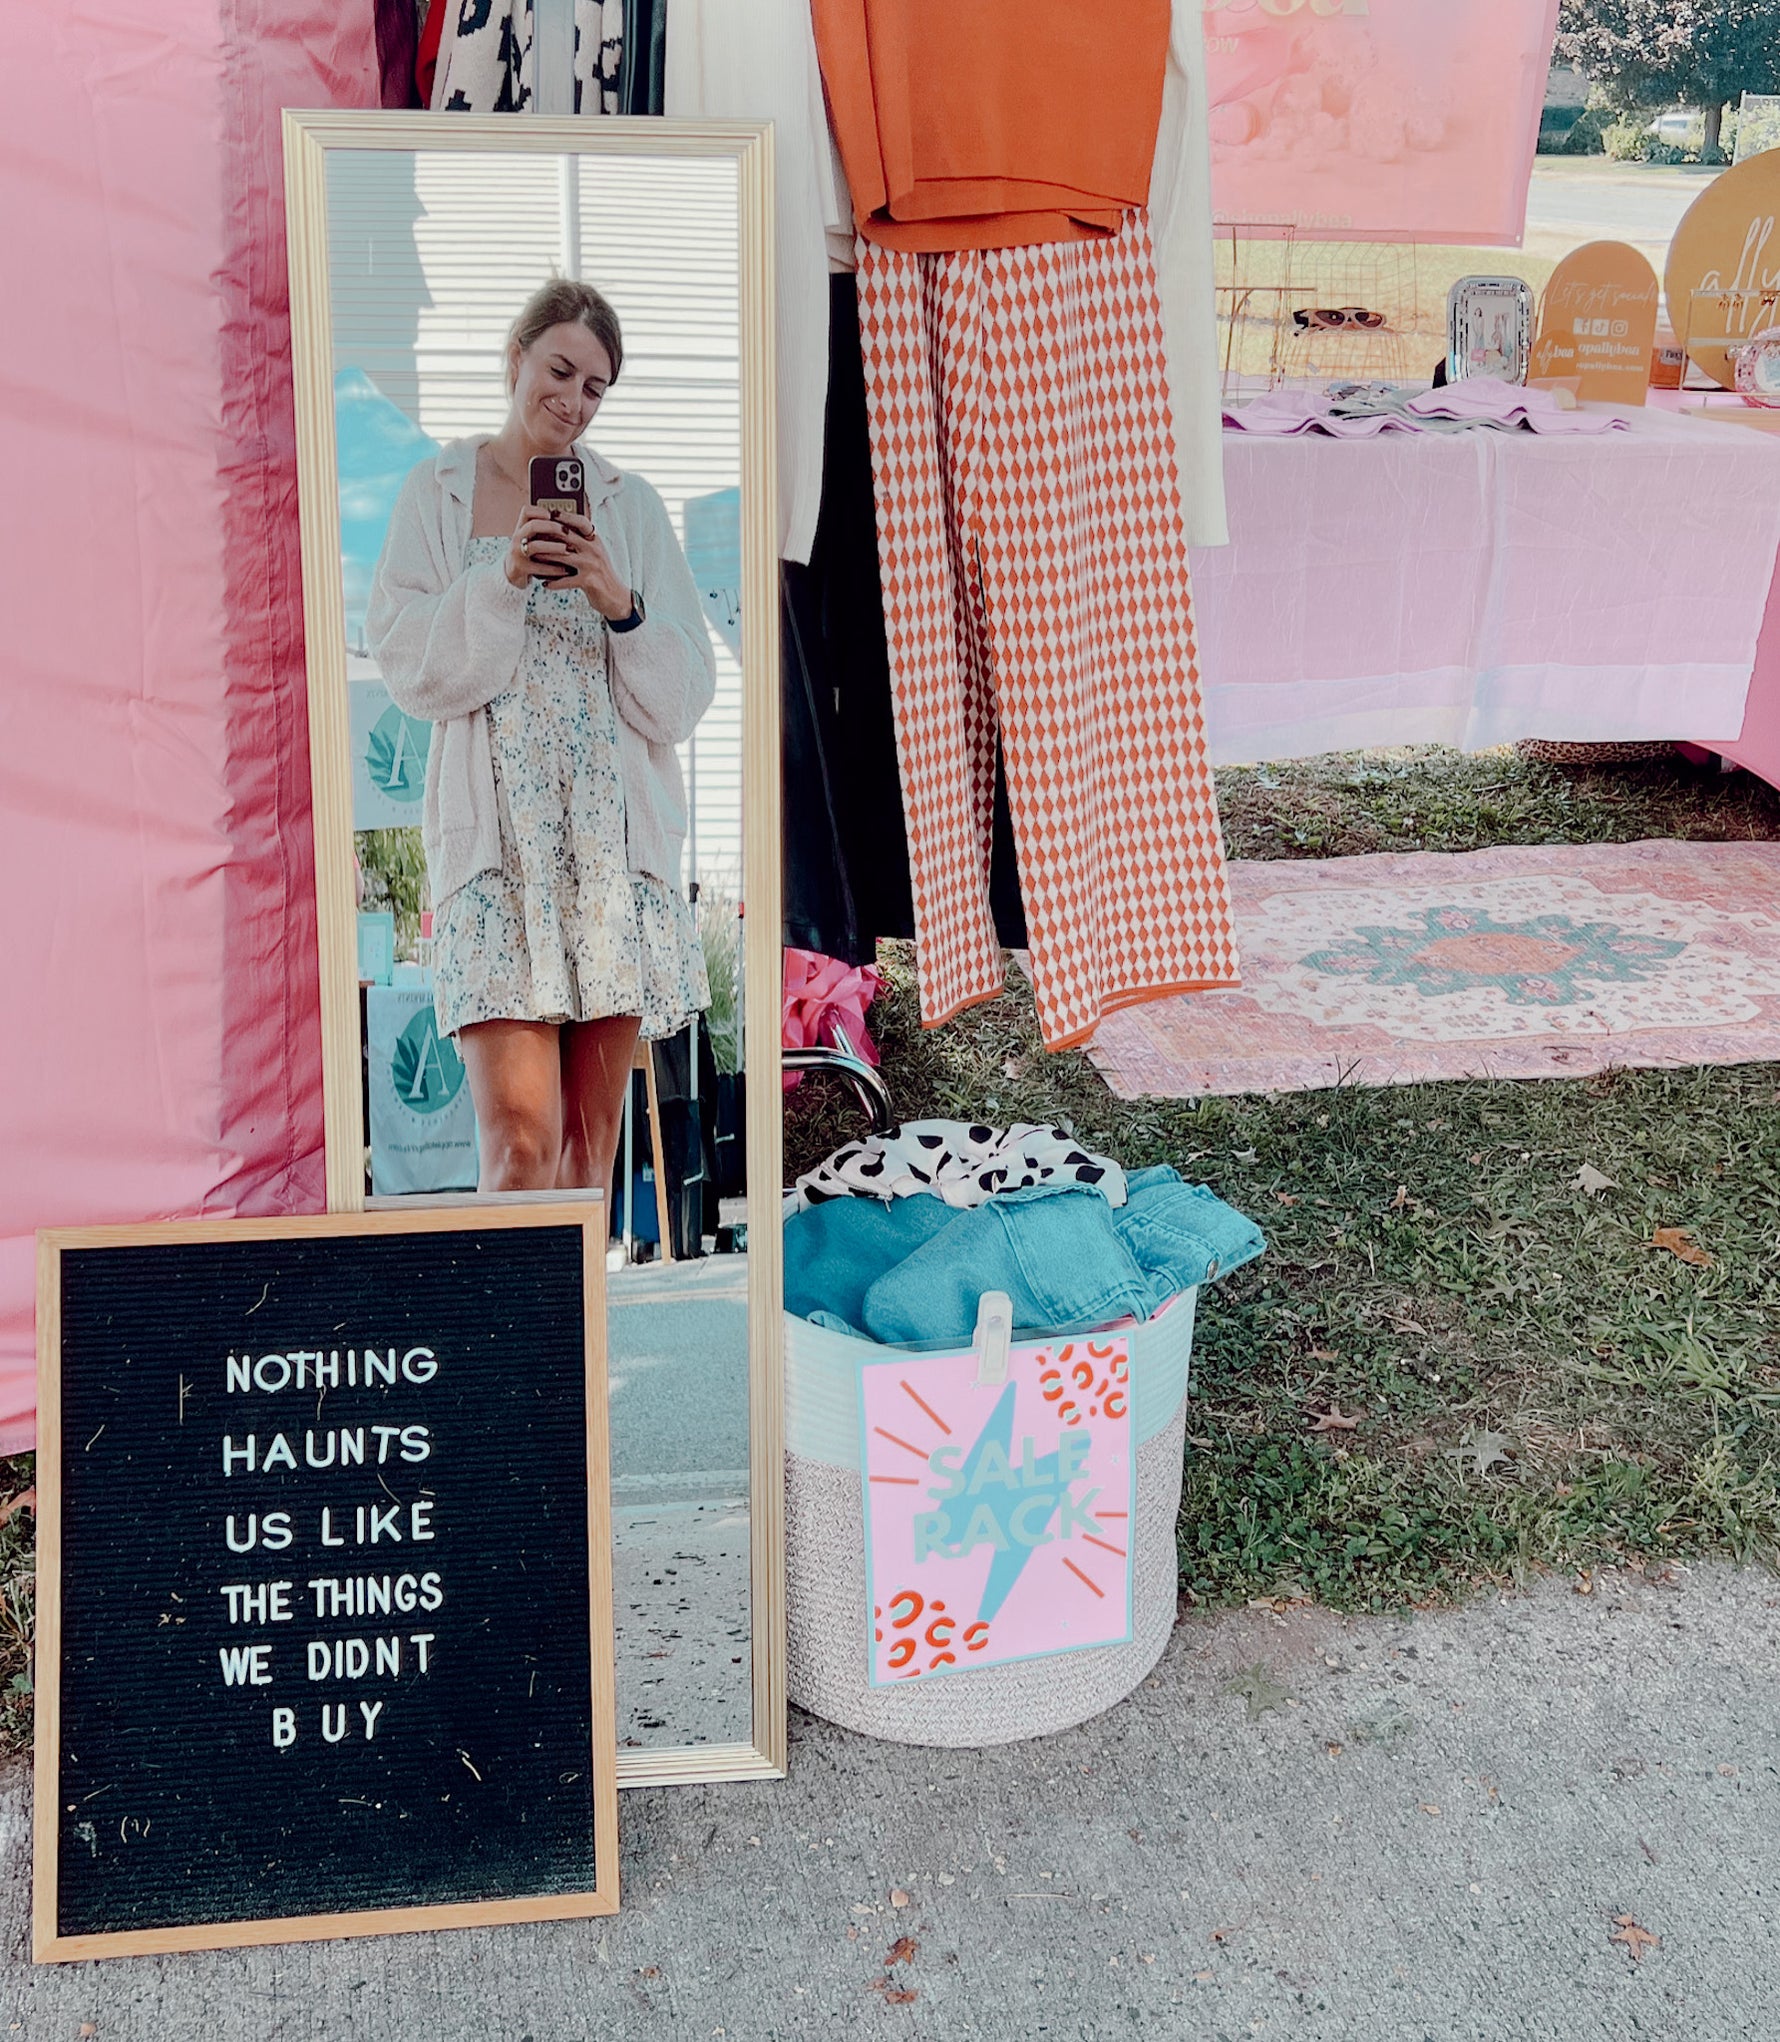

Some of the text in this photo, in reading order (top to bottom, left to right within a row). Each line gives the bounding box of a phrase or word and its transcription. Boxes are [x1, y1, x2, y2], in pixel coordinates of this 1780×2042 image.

[1578, 342, 1640, 358] opallybea
[226, 1346, 438, 1393] NOTHING
[223, 1425, 431, 1475] HAUNTS
[927, 1429, 1091, 1500] SALE
[226, 1501, 435, 1553] US LIKE
[913, 1486, 1105, 1565] RACK
[221, 1573, 443, 1625] THE THINGS
[220, 1645, 273, 1685] WE
